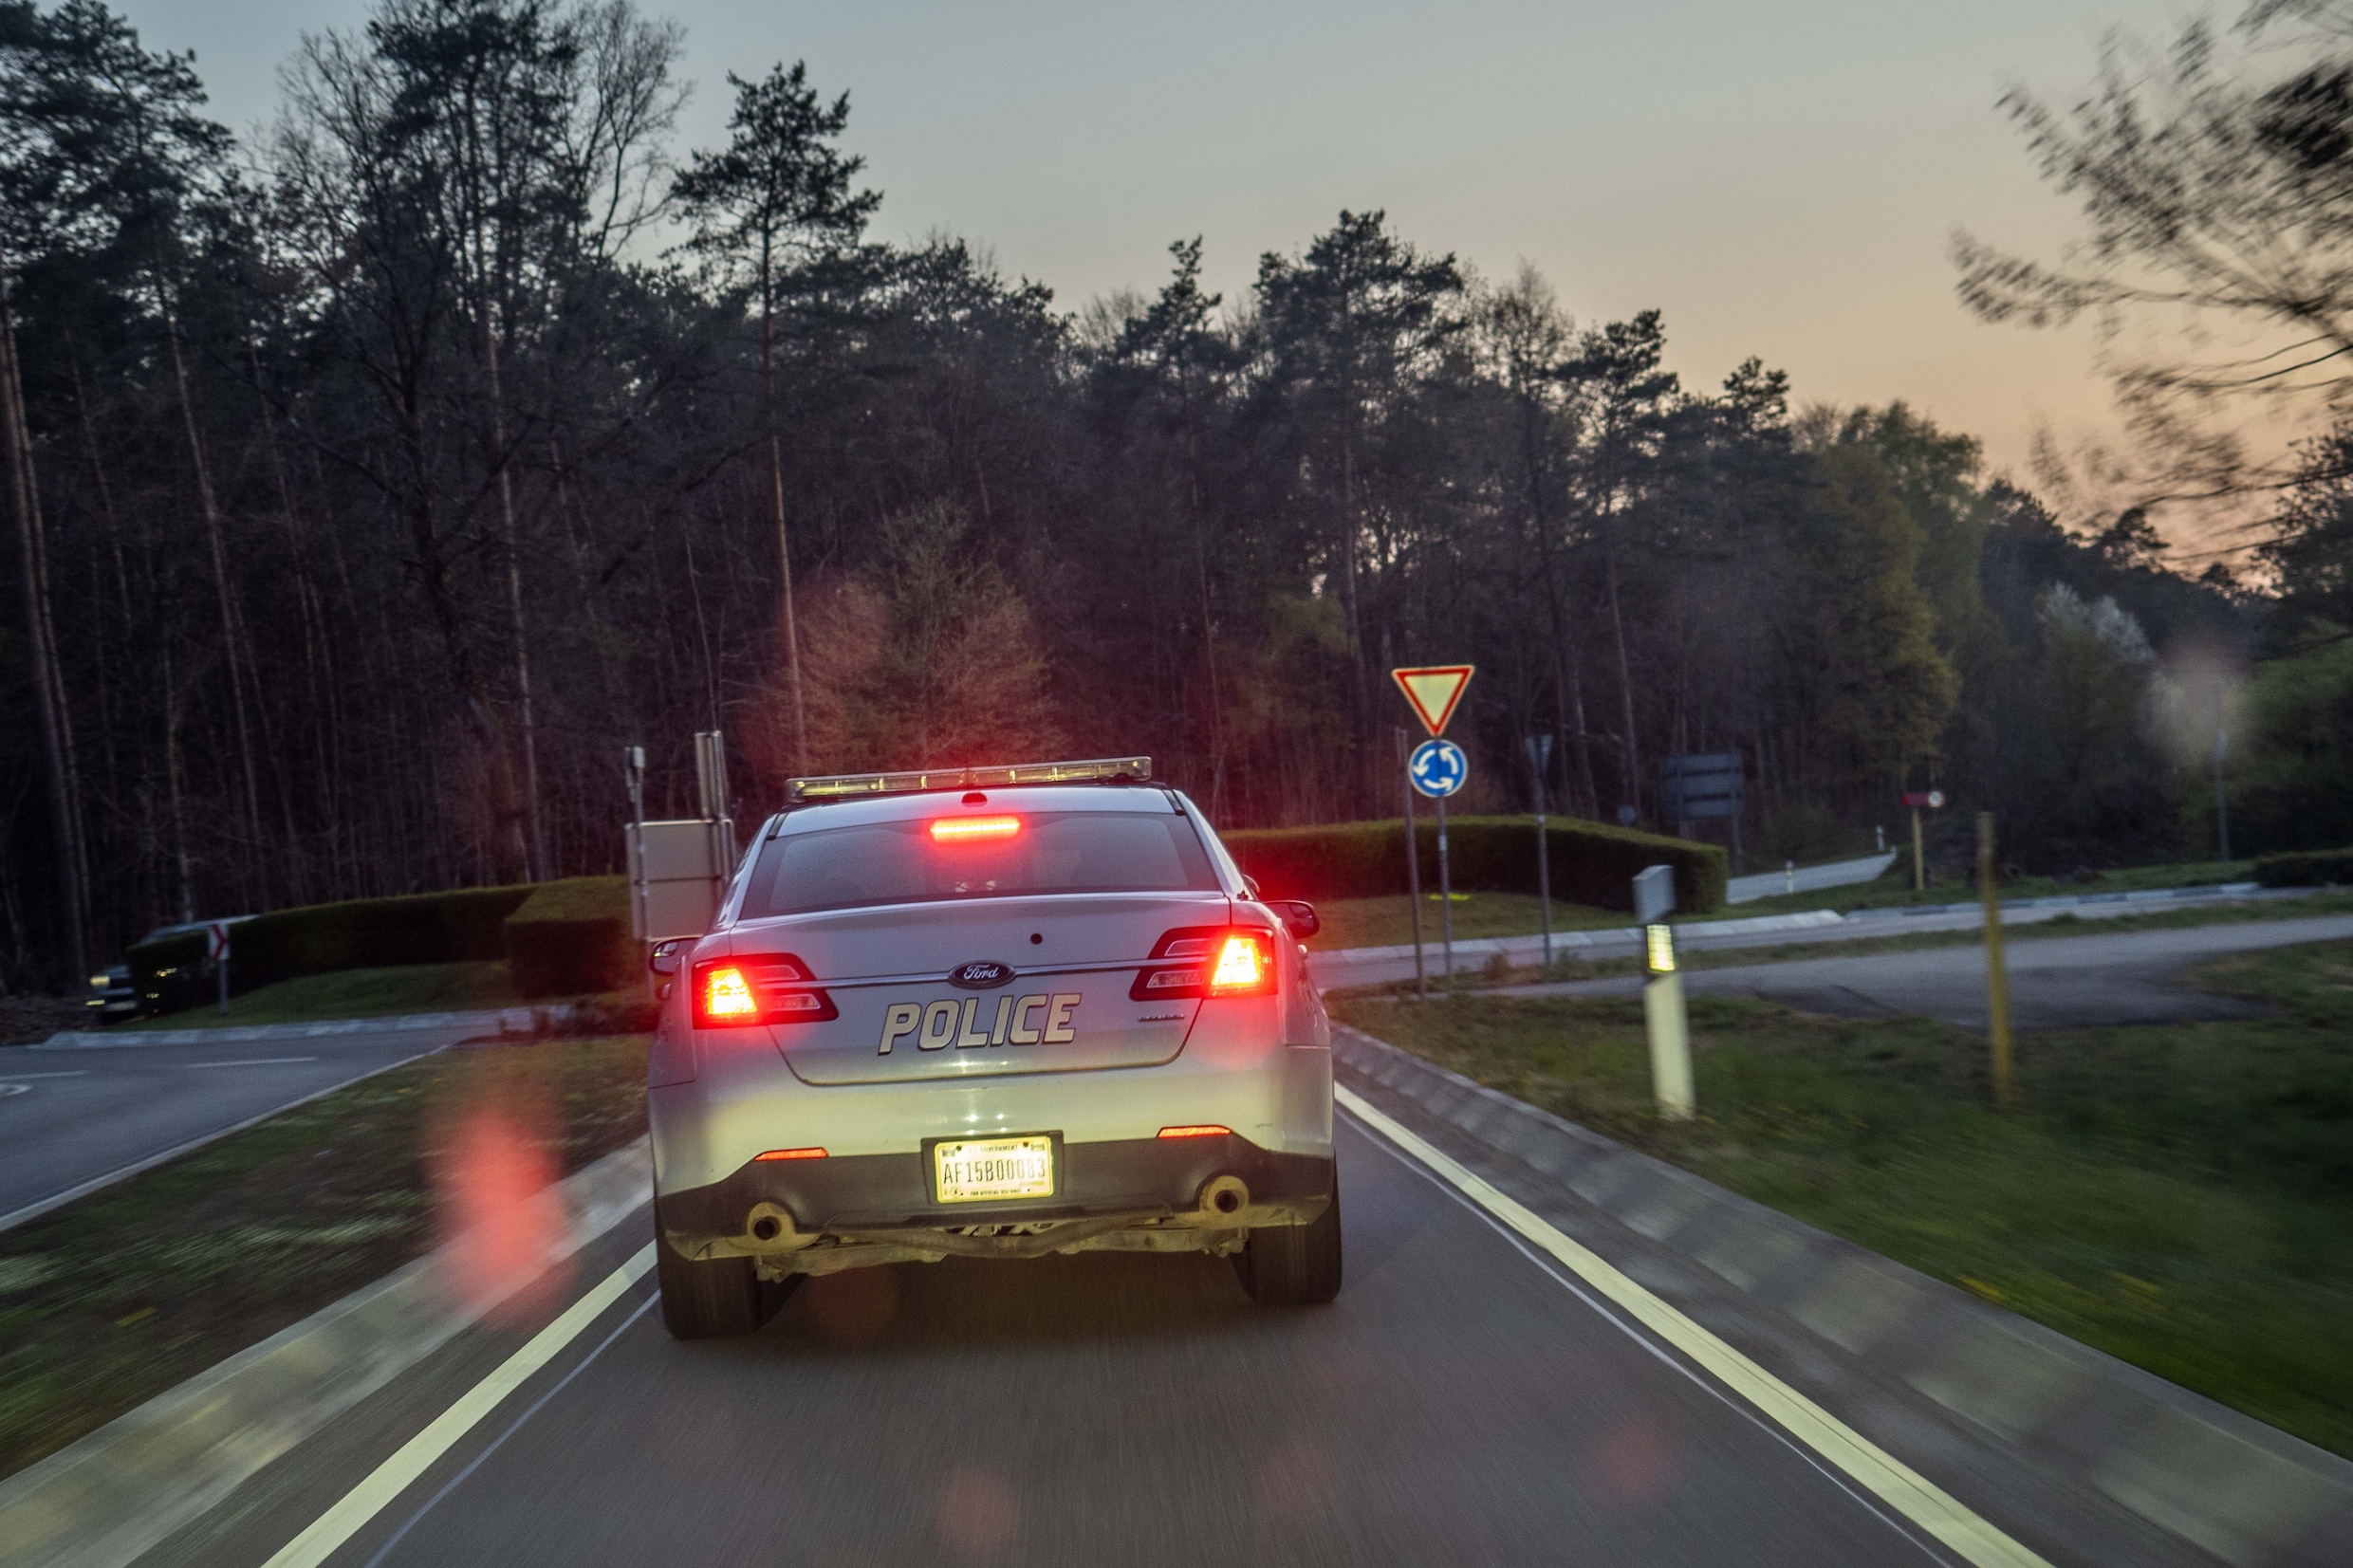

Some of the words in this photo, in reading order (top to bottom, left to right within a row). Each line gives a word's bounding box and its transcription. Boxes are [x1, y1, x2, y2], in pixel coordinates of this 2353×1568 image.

[963, 964, 999, 980] Ford
[878, 993, 1082, 1056] POLICE
[943, 1157, 1046, 1184] AF15B00083
